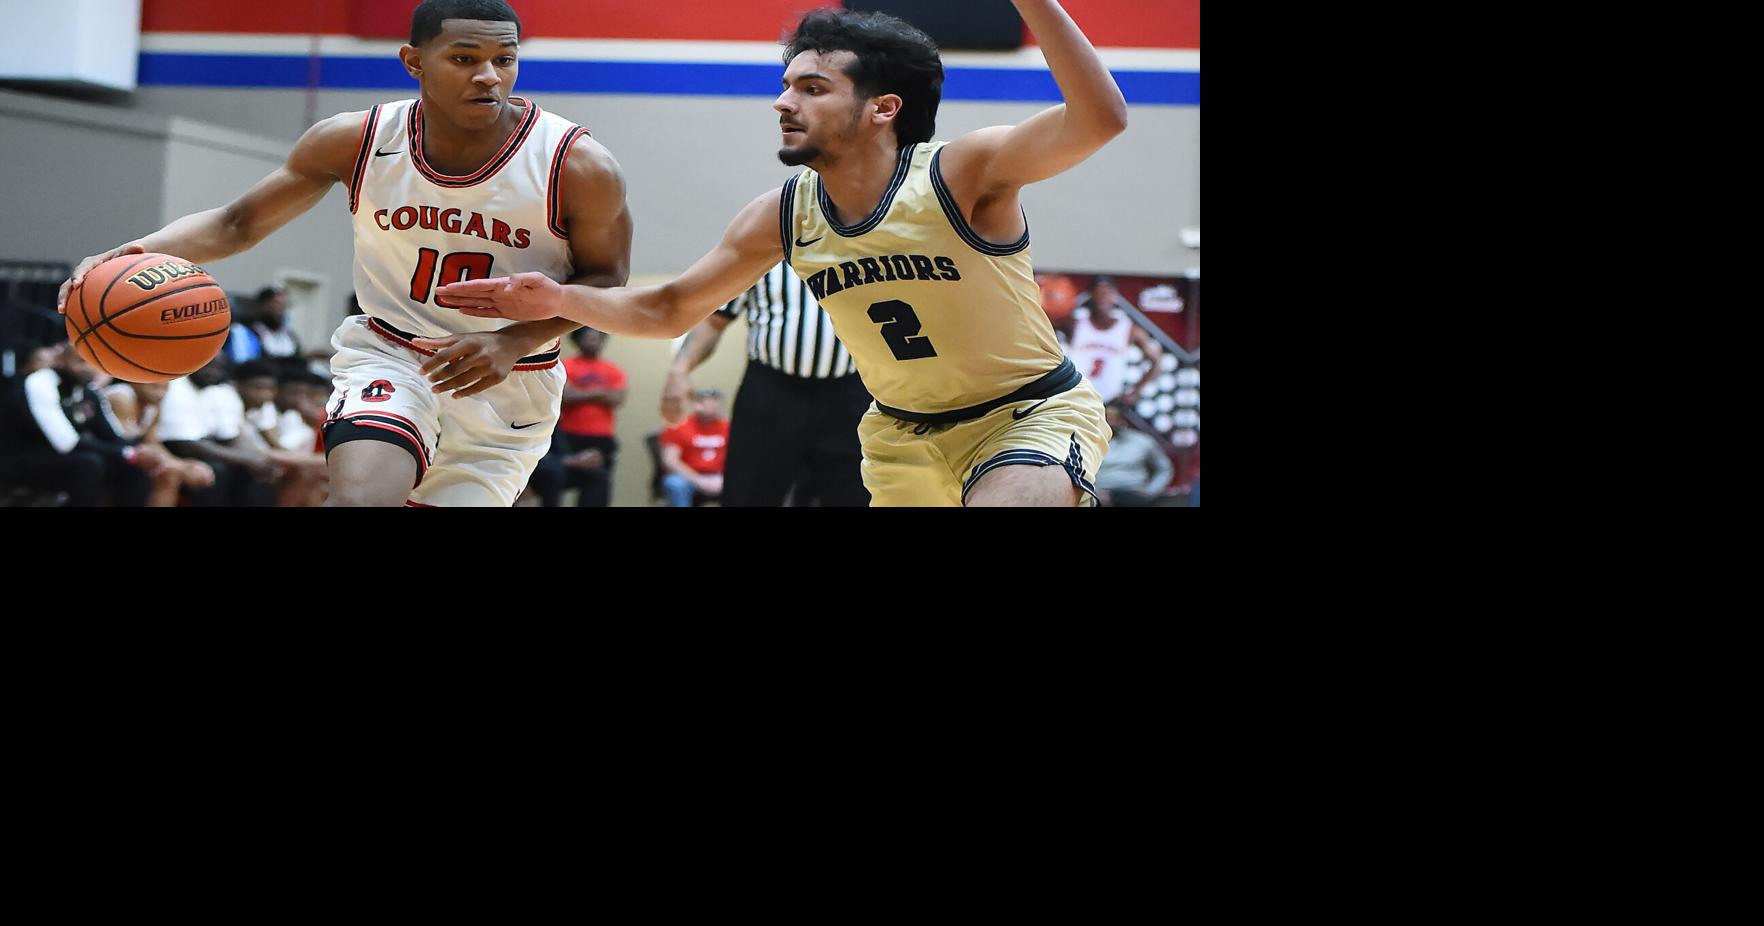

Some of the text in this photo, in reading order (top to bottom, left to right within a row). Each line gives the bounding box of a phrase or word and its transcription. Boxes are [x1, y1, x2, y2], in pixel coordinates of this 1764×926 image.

[374, 205, 531, 249] COUGARS
[126, 260, 208, 290] Wilso
[409, 247, 495, 309] 10
[806, 254, 962, 301] WARRIORS
[867, 299, 938, 361] 2
